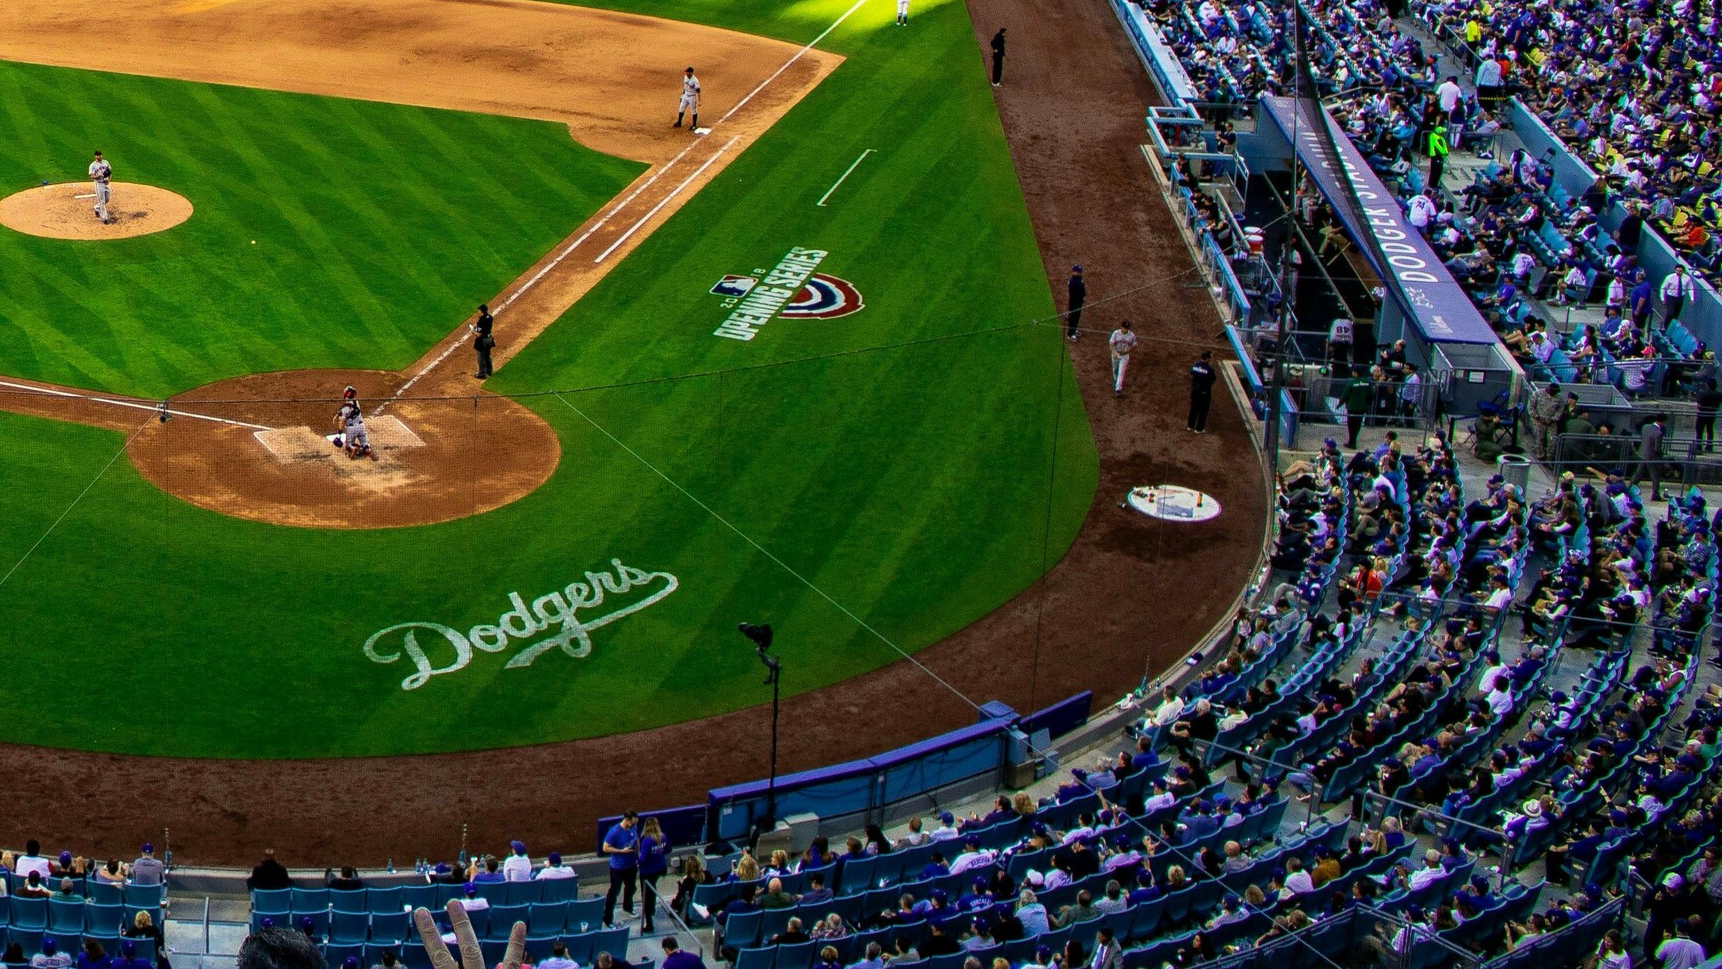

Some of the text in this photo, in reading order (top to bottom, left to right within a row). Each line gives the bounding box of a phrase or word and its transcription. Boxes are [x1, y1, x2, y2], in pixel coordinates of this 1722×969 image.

[1363, 207, 1438, 283] DODGER
[712, 246, 828, 342] OPENING SERIES
[363, 557, 679, 691] Dodgers
